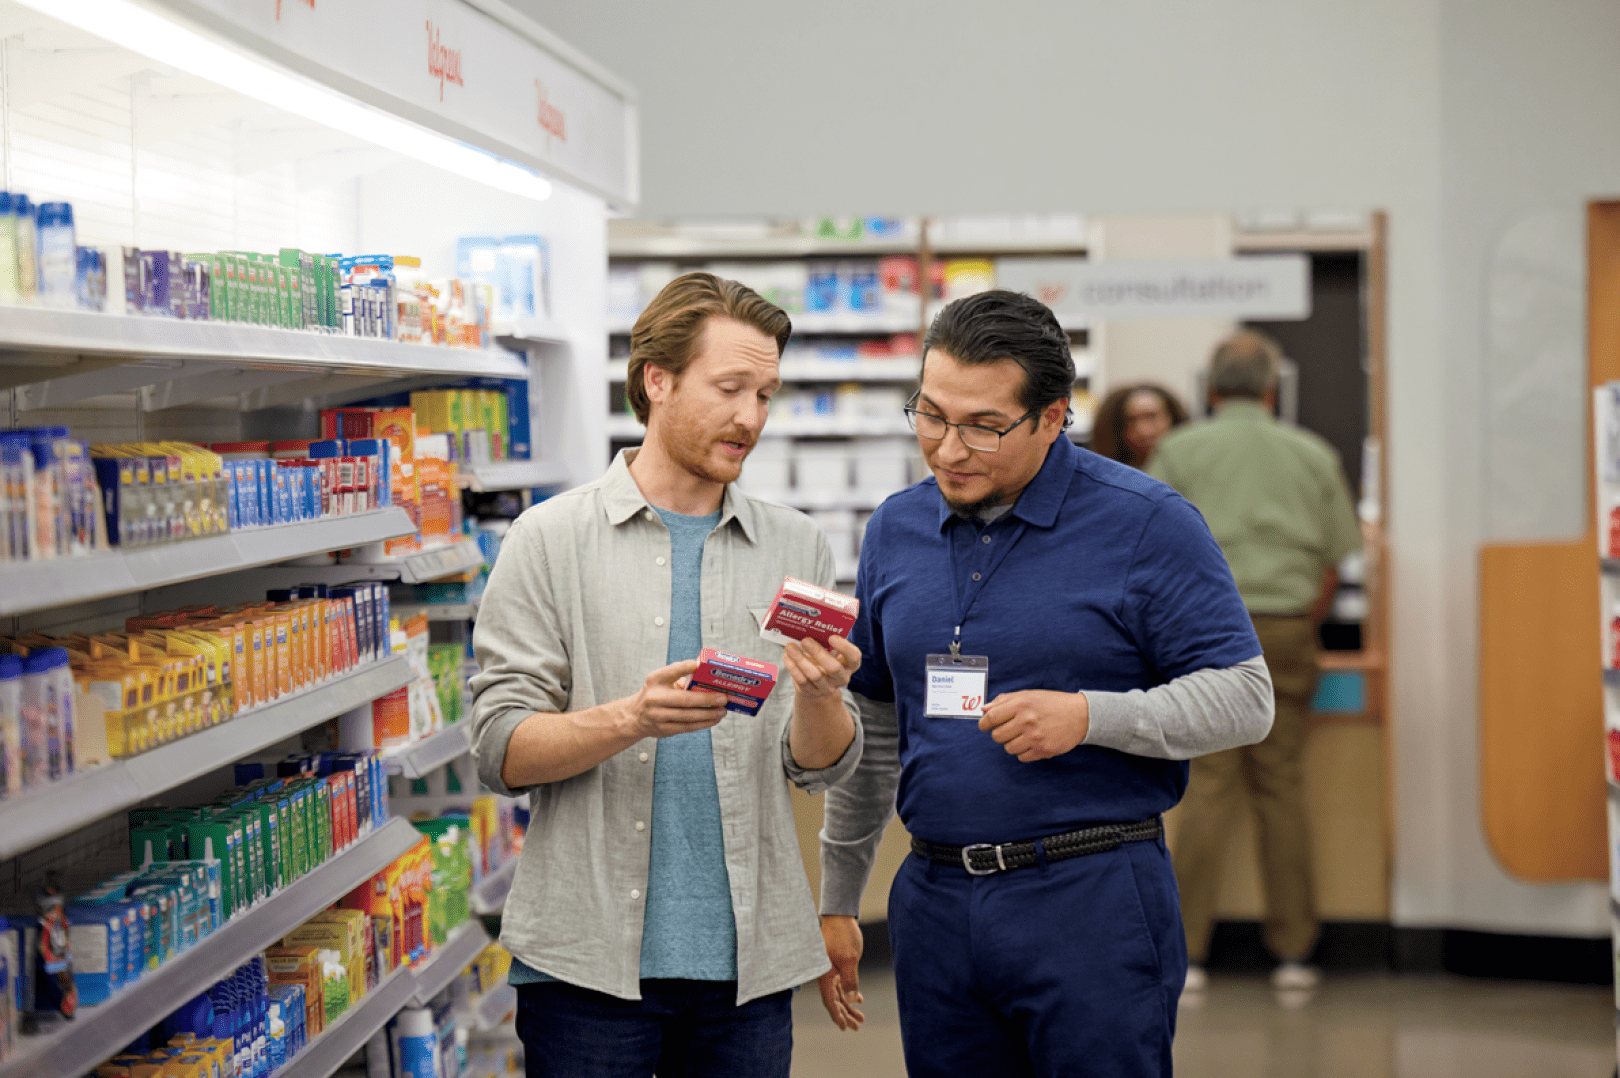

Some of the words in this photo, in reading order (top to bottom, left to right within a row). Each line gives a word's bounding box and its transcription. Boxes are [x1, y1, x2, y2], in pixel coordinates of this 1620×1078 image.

[780, 609, 813, 625] Allergy
[814, 620, 843, 634] Relief
[715, 669, 759, 686] Benadryl
[932, 675, 954, 684] Daniel
[712, 679, 751, 692] ALLERGY
